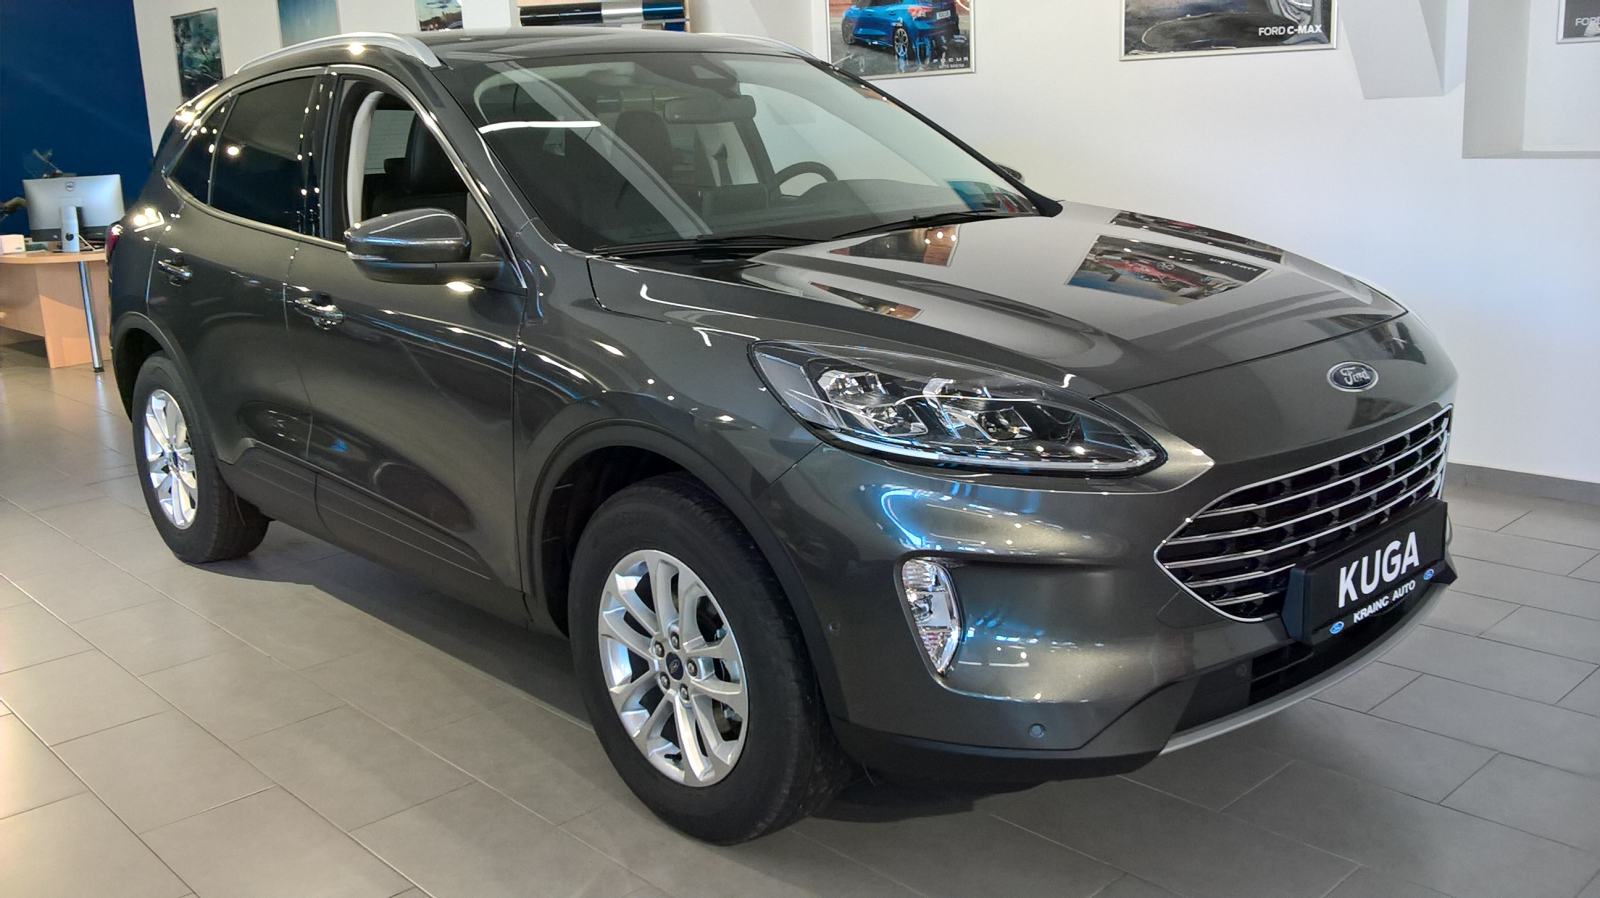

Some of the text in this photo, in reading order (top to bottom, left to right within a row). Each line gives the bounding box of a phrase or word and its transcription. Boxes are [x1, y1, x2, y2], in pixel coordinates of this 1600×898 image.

[1258, 24, 1323, 36] FORD C-MAX
[1339, 366, 1371, 386] Ford
[1338, 531, 1420, 608] KUGA
[1353, 579, 1416, 623] KRAINC AUTO
